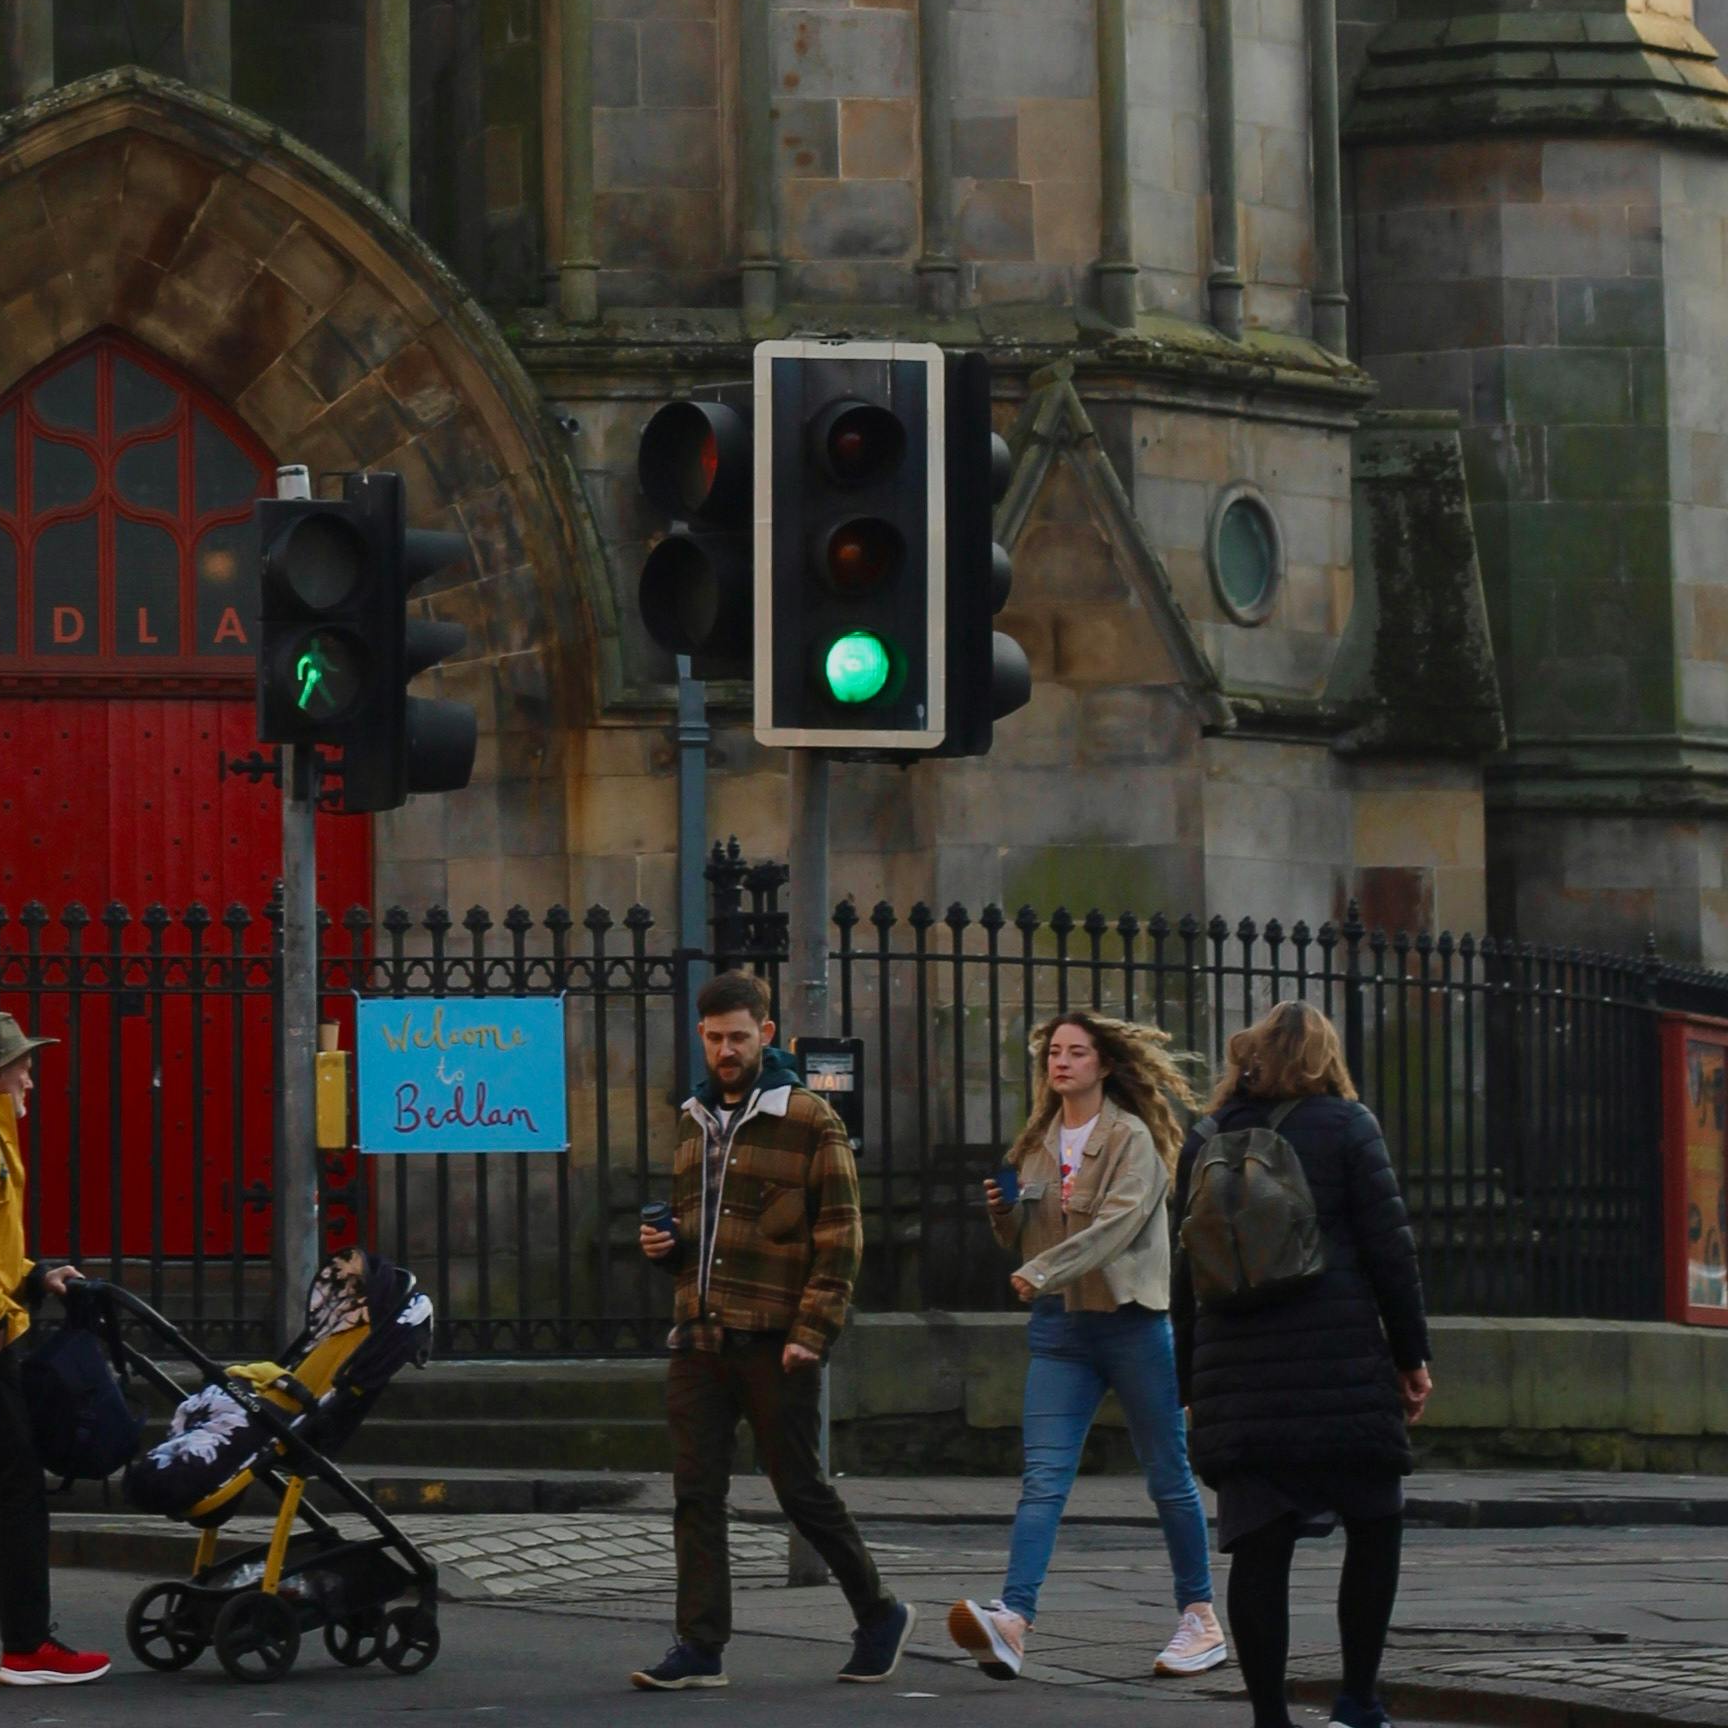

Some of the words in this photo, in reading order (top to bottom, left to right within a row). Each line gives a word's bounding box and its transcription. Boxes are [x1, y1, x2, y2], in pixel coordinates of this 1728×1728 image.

[382, 1006, 529, 1053] Welcome
[436, 1056, 465, 1085] to
[808, 1074, 849, 1090] WAIT
[393, 1081, 539, 1133] Bedlam
